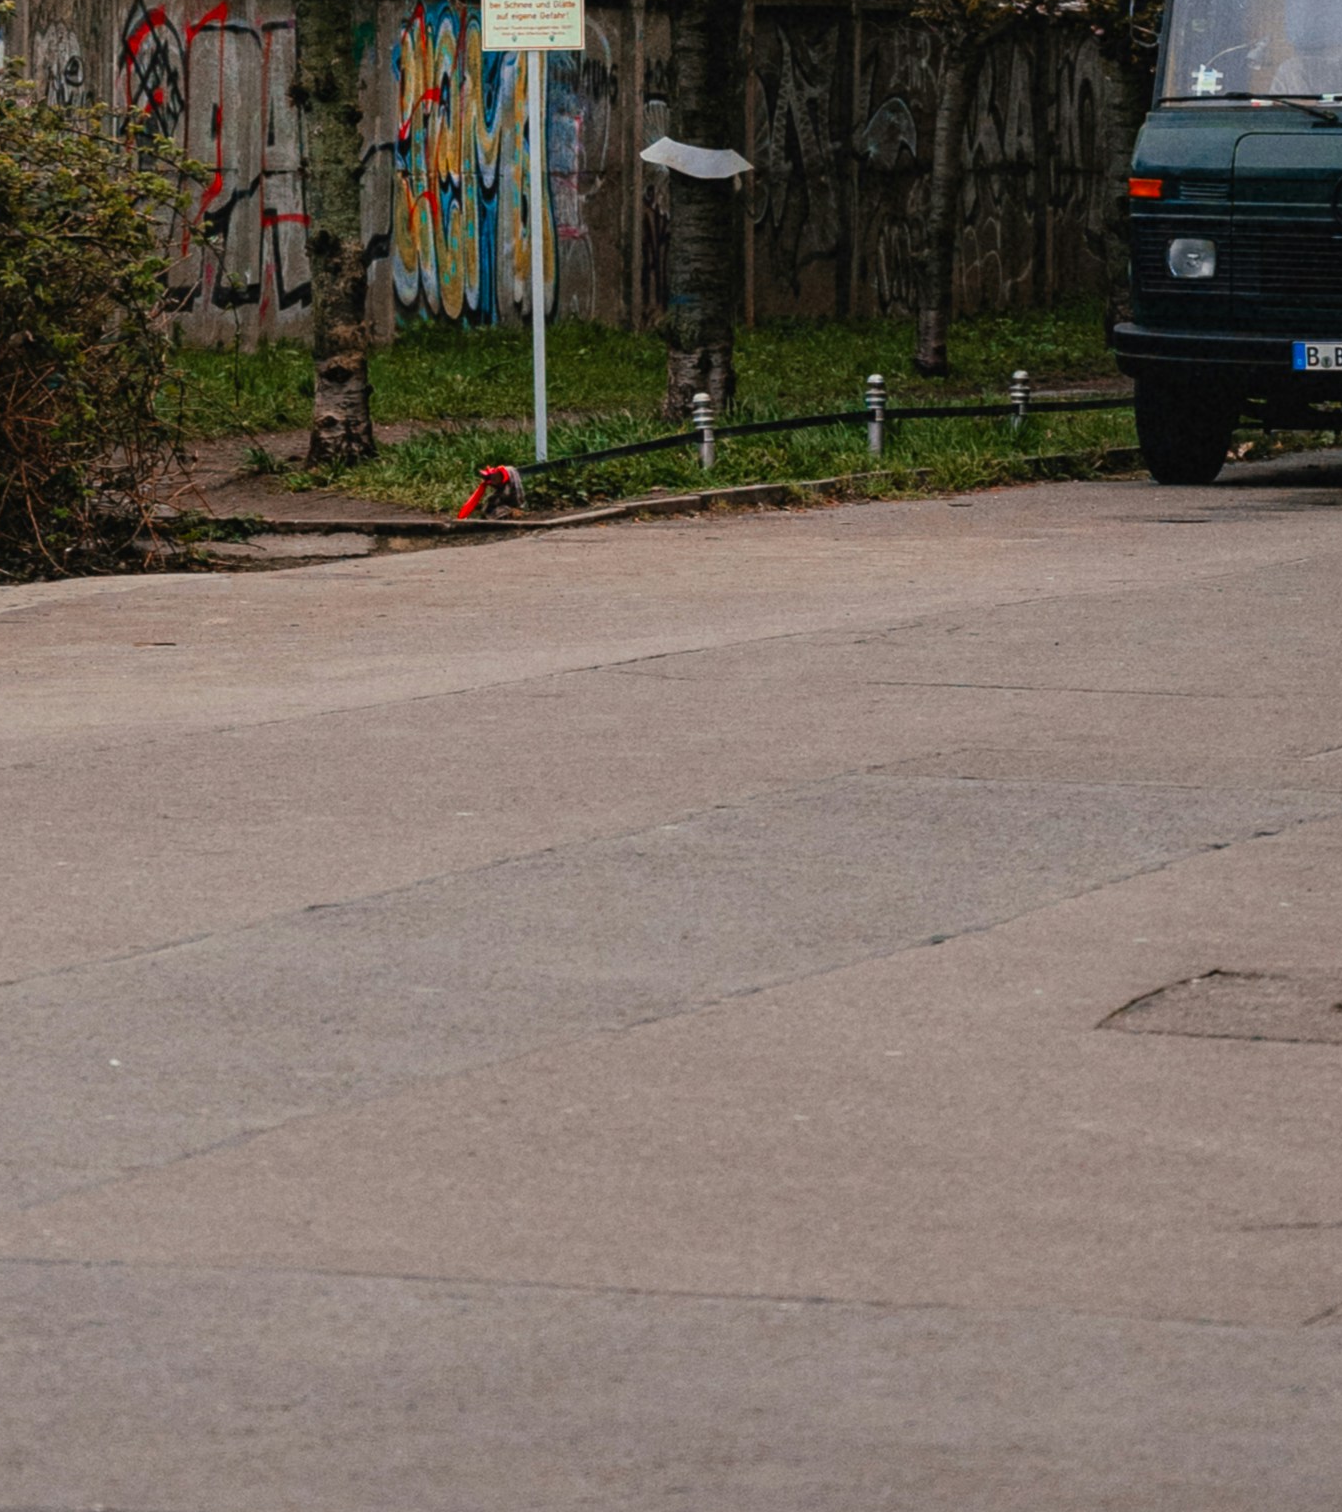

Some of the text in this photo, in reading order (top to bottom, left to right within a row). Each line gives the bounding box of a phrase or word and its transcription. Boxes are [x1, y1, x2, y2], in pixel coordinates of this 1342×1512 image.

[504, 1, 532, 9] Schnee
[496, 12, 508, 20] auf
[511, 13, 537, 21] eigene
[1307, 346, 1320, 367] B
